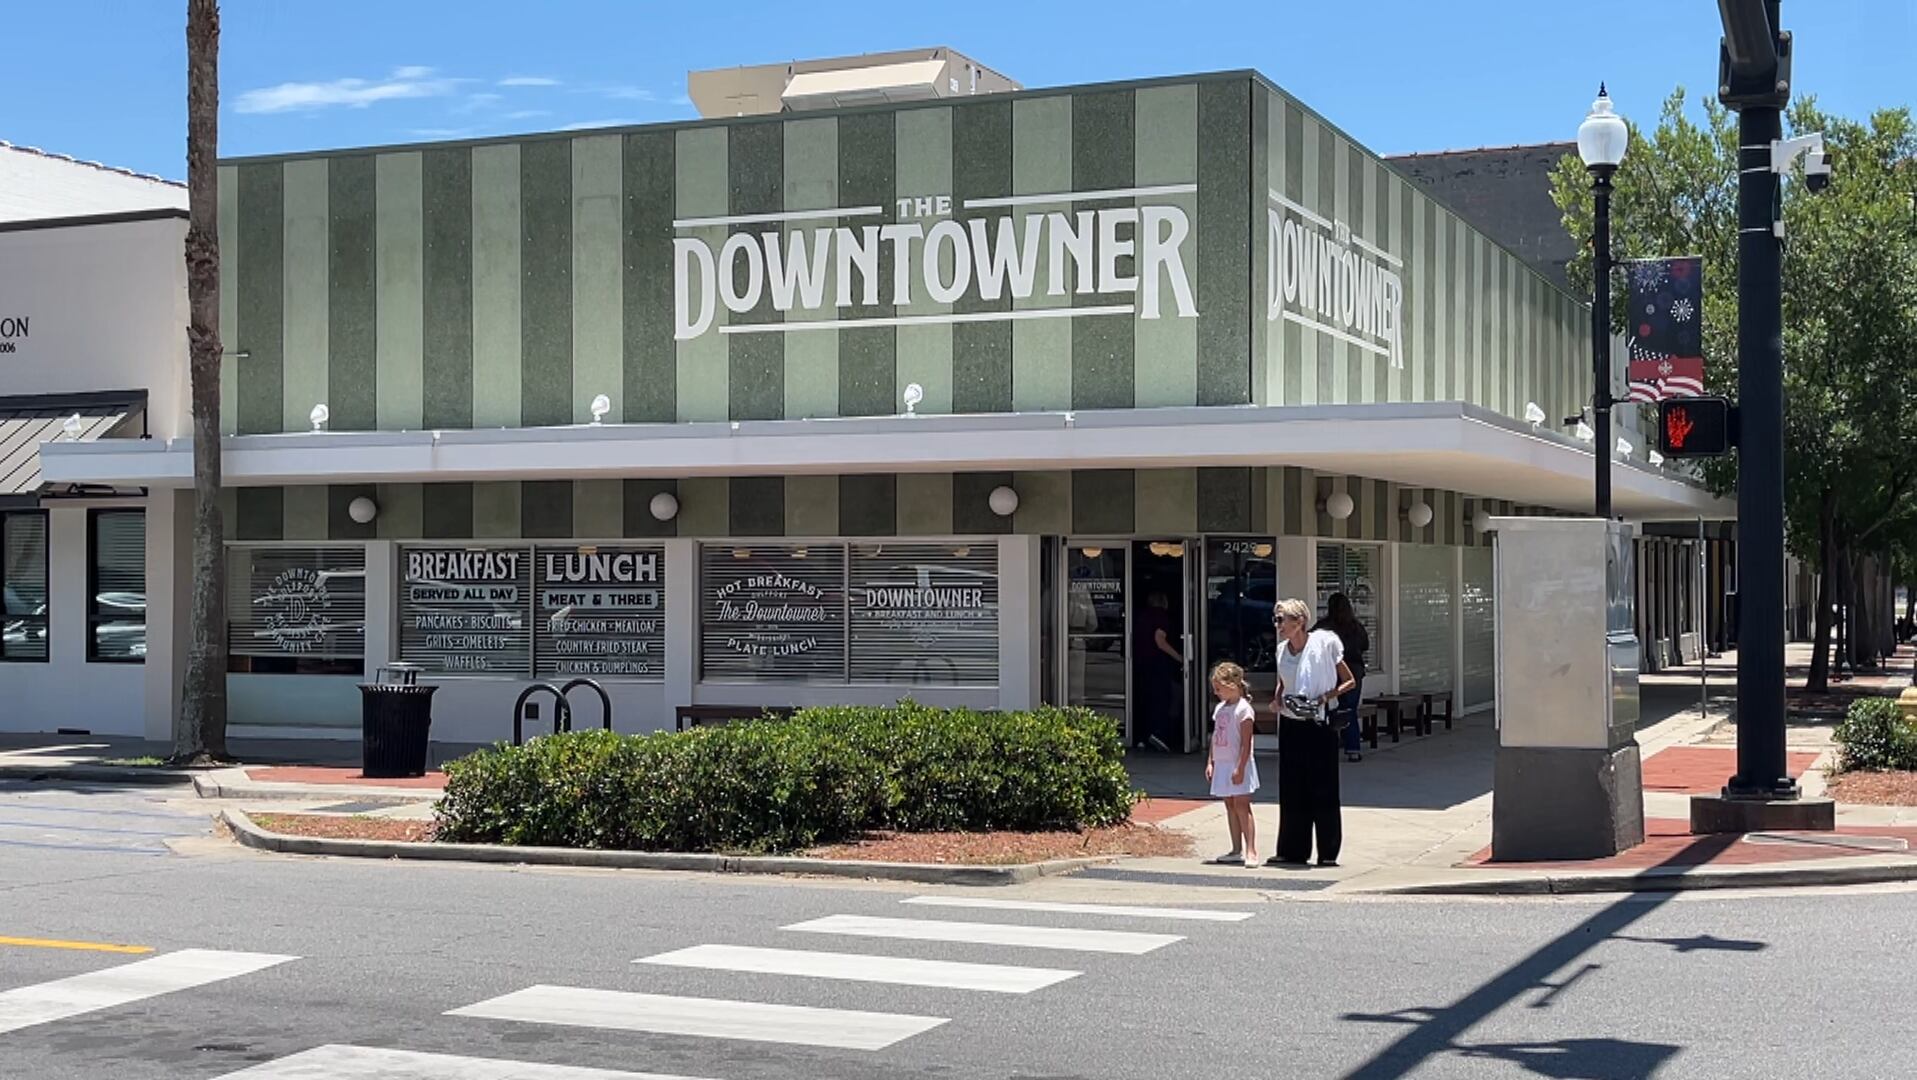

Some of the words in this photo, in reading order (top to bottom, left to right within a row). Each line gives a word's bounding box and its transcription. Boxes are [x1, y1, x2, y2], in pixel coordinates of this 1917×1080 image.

[897, 195, 952, 217] THE
[673, 204, 1198, 340] DOWNTOWNER
[1268, 208, 1404, 369] DOWNTOWNER
[0, 316, 30, 337] ON
[409, 553, 519, 579] BREAKFAST
[546, 554, 657, 581] LUNCH
[412, 588, 459, 599] SERVED
[464, 588, 486, 599] ALL
[490, 588, 514, 599] DAY
[716, 581, 741, 599] HOT
[747, 576, 824, 599] BREAKFAST
[548, 594, 586, 605] MEAT
[592, 594, 602, 605] &
[609, 594, 652, 605] THREE
[866, 588, 982, 607] DOWNTOWNER
[716, 600, 741, 621] The
[743, 600, 827, 621] Downtowner
[875, 610, 921, 619] BREAKFAST
[925, 610, 943, 619] AND
[946, 610, 974, 619] LUNCH
[415, 616, 463, 629] PANCAKES
[471, 616, 514, 629] BISCUITS
[546, 620, 569, 633] FRIED
[572, 620, 607, 633] CHICKEN
[615, 620, 656, 633] MEATLOAF
[425, 634, 453, 648] GRITS
[462, 634, 505, 648] OMELETS
[556, 640, 594, 653] COUNTRY
[622, 640, 648, 653] STEAK
[727, 637, 767, 655] PLATE
[773, 635, 817, 655] LUNCH
[445, 656, 487, 669] WAFFLES
[556, 661, 590, 673] CHICKEN
[592, 661, 599, 673] &
[602, 661, 648, 673] DUMPLINGS
